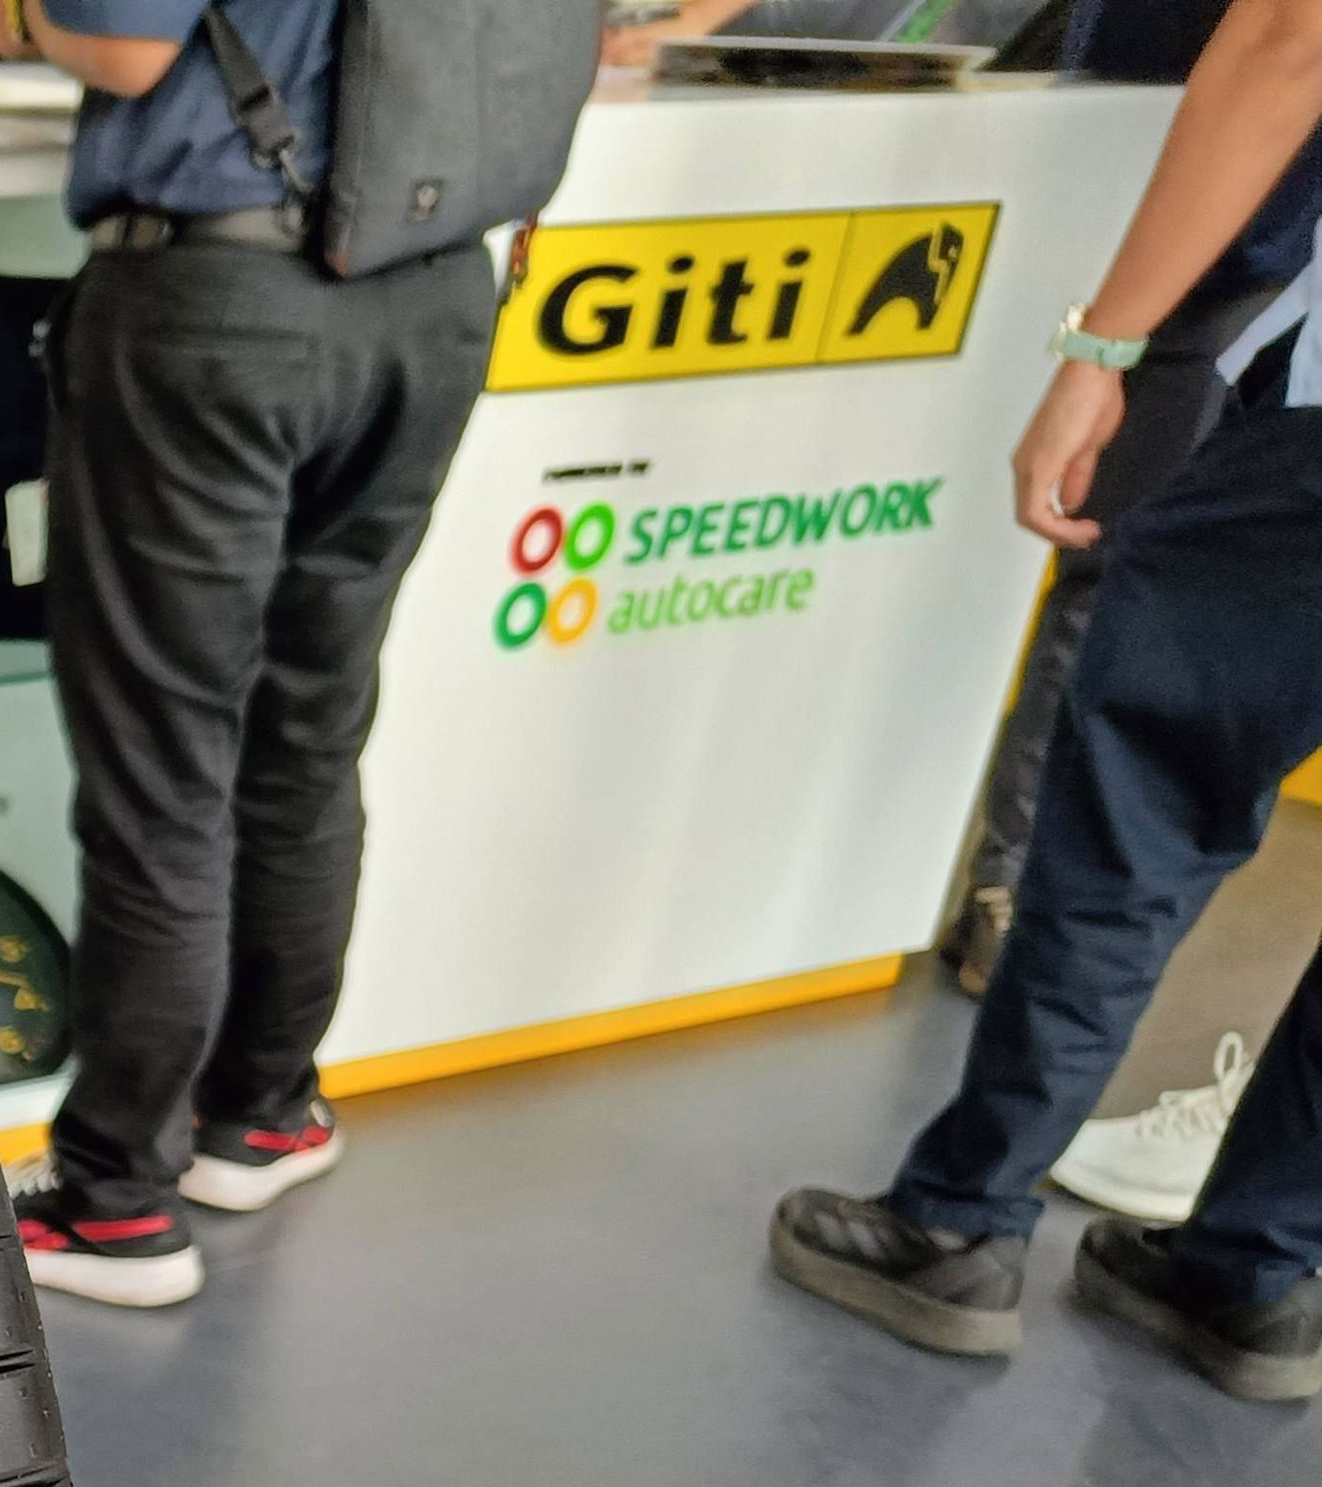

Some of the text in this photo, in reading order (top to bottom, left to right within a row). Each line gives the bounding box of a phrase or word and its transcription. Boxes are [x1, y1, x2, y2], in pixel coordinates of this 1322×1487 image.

[538, 247, 813, 357] Giti
[623, 476, 944, 566] SPEEDWORK
[607, 567, 816, 635] autocare
